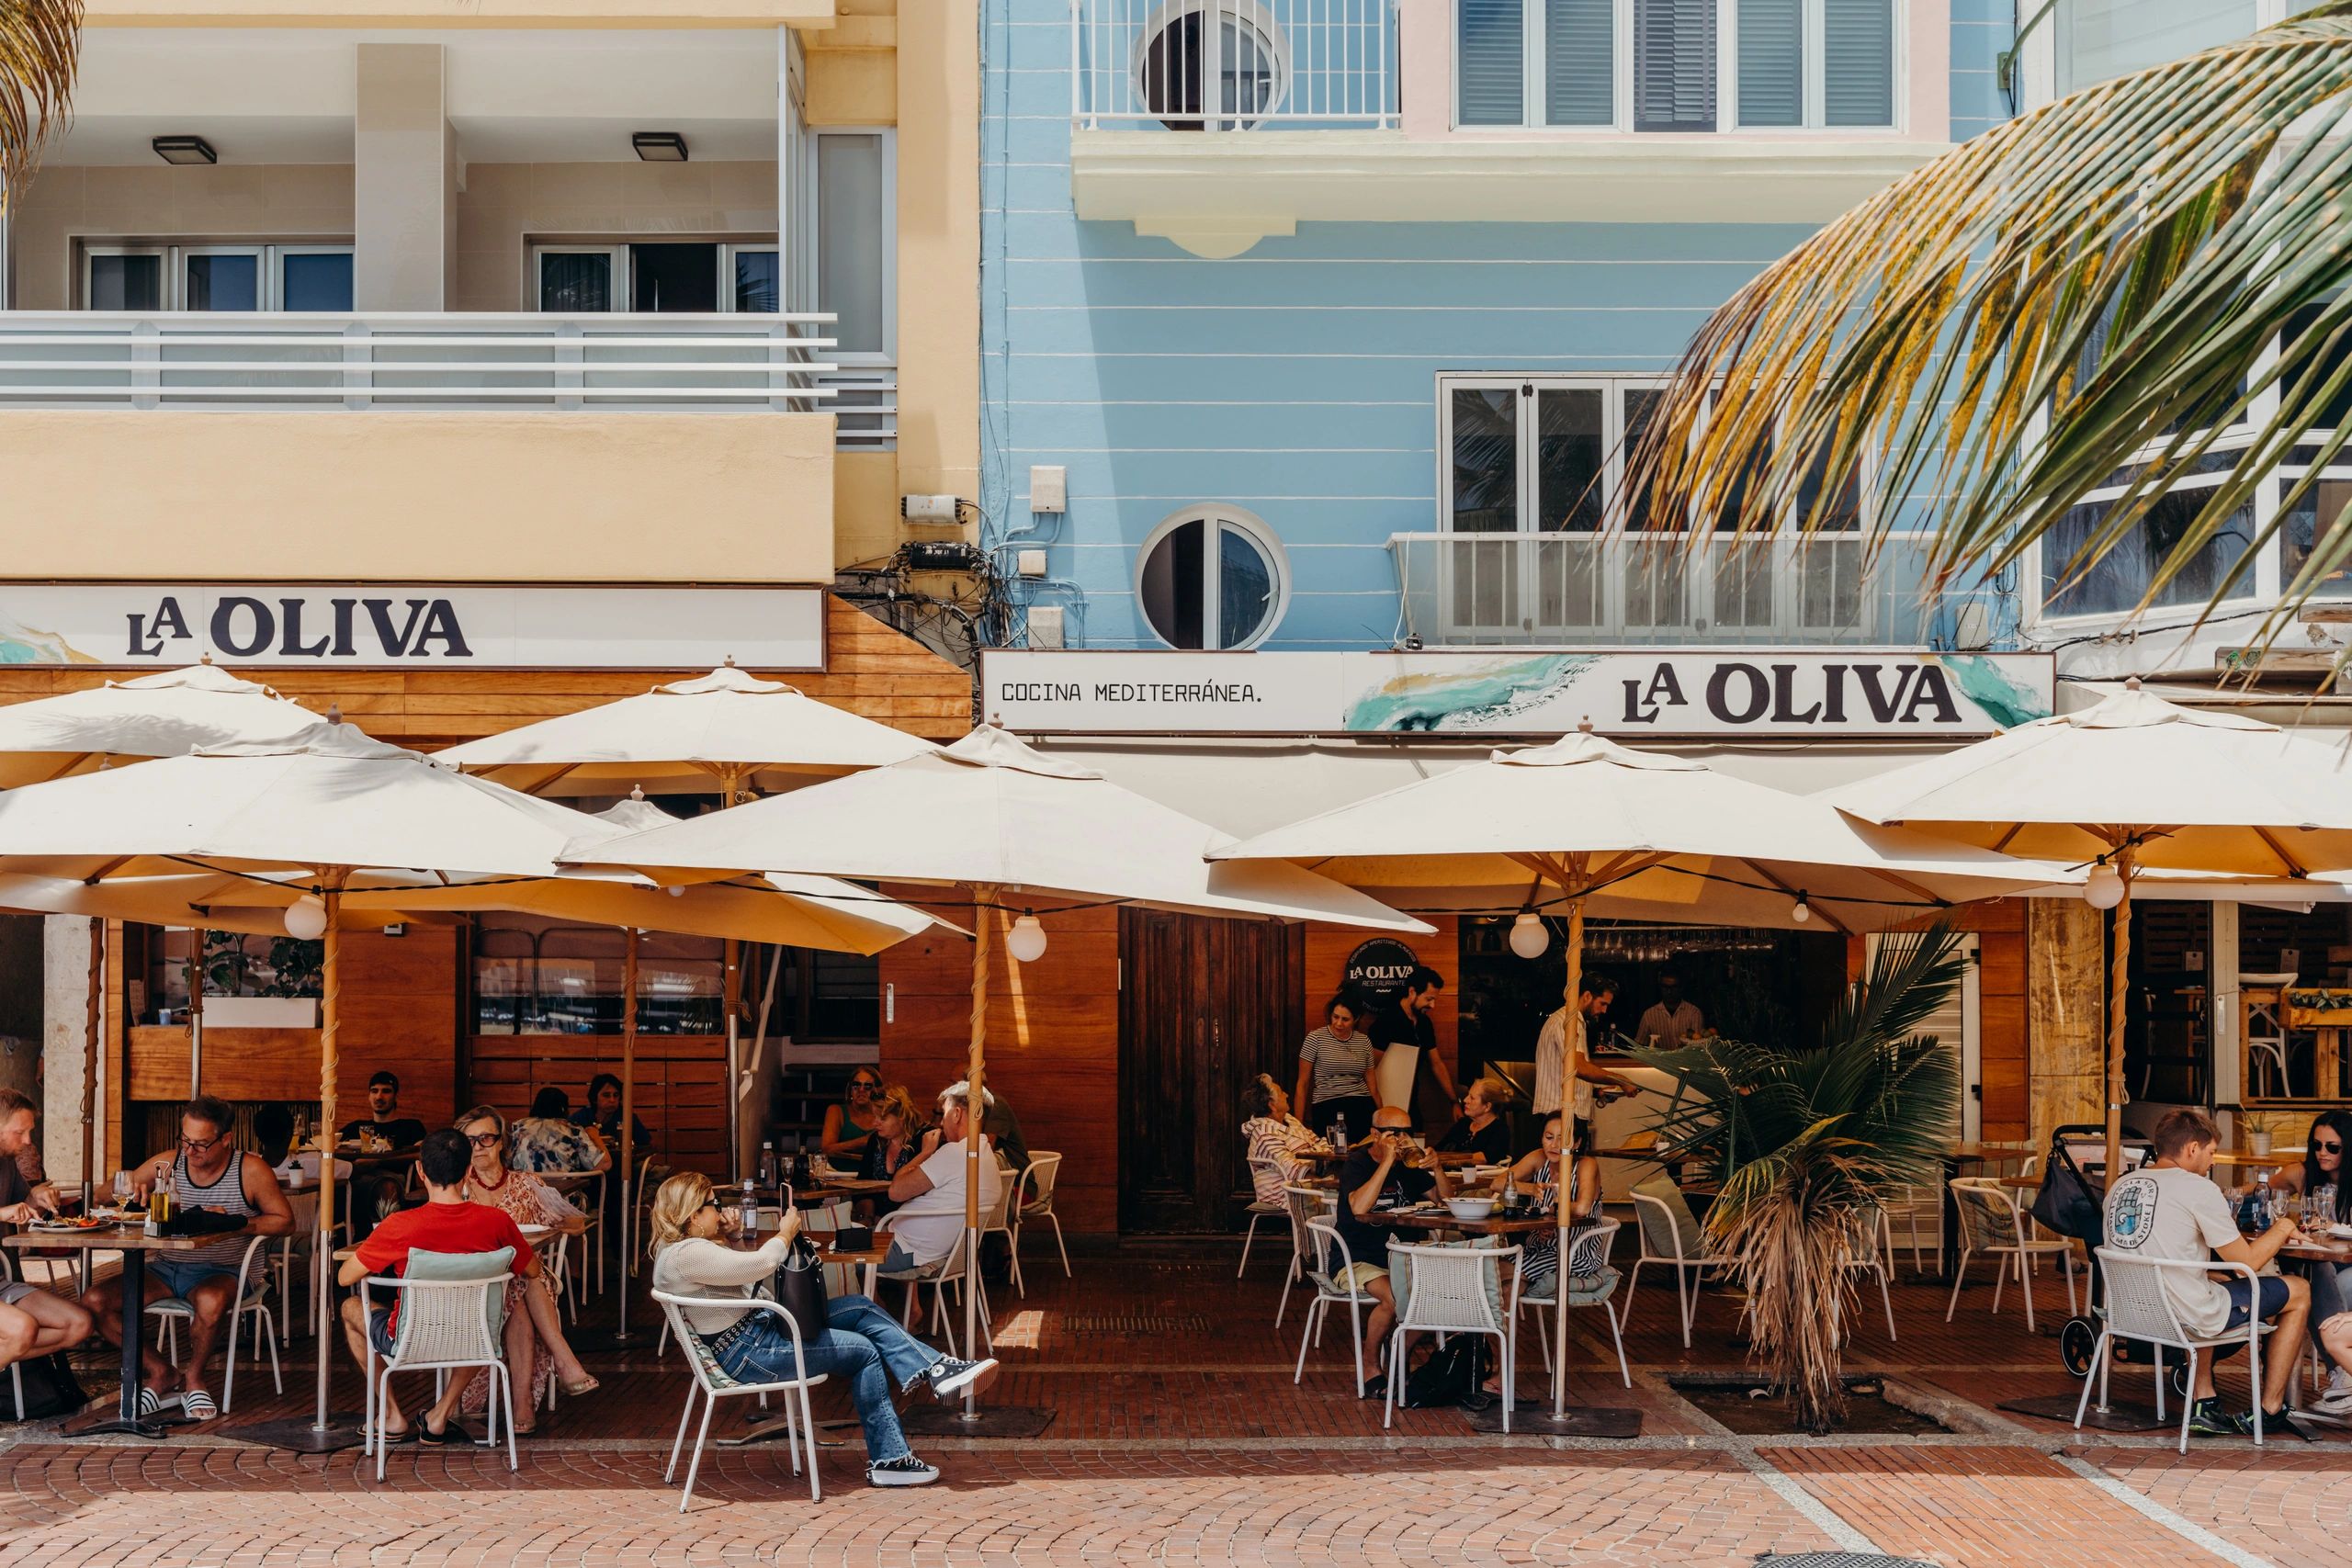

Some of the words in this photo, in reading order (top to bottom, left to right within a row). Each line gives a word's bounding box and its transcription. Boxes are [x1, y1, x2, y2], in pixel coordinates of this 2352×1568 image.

[126, 596, 193, 657] LA
[210, 596, 474, 657] OLIVA
[1001, 682, 1081, 702] COCINA
[1094, 678, 1262, 703] MEDITERRÁNEA.
[1622, 662, 1689, 724] LA
[1706, 662, 1962, 724] OLIVA
[1350, 966, 1363, 979] LA
[1365, 966, 1414, 979] OLIVA
[2137, 1211, 2151, 1239] STOKE
